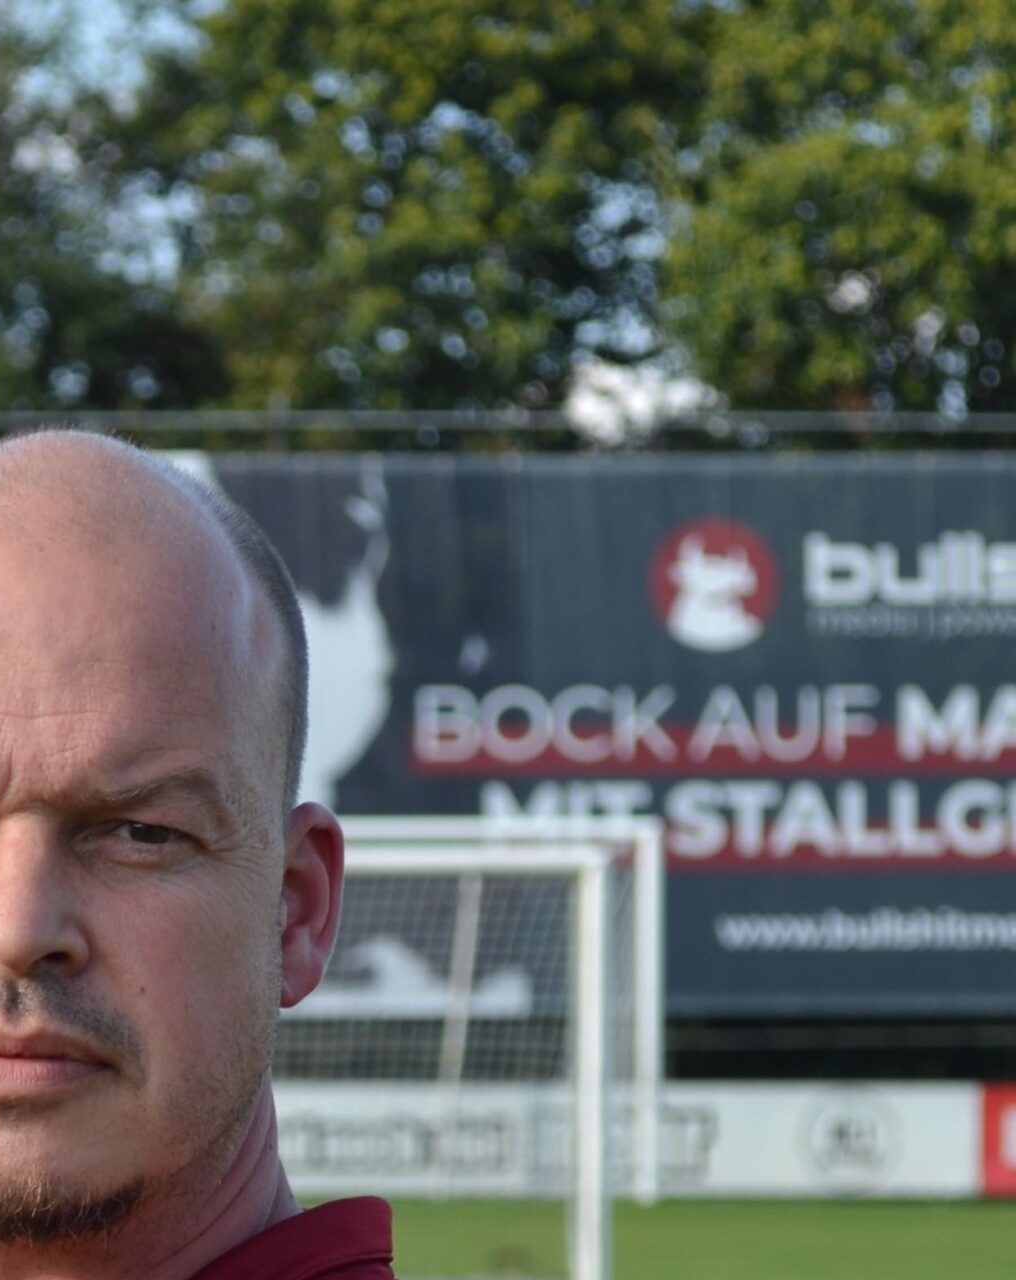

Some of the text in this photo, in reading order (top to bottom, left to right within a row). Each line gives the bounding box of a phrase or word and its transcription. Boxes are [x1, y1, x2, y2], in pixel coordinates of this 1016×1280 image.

[414, 683, 677, 763] BOCK
[688, 683, 880, 763] AUF
[665, 778, 1016, 858] STALLG
